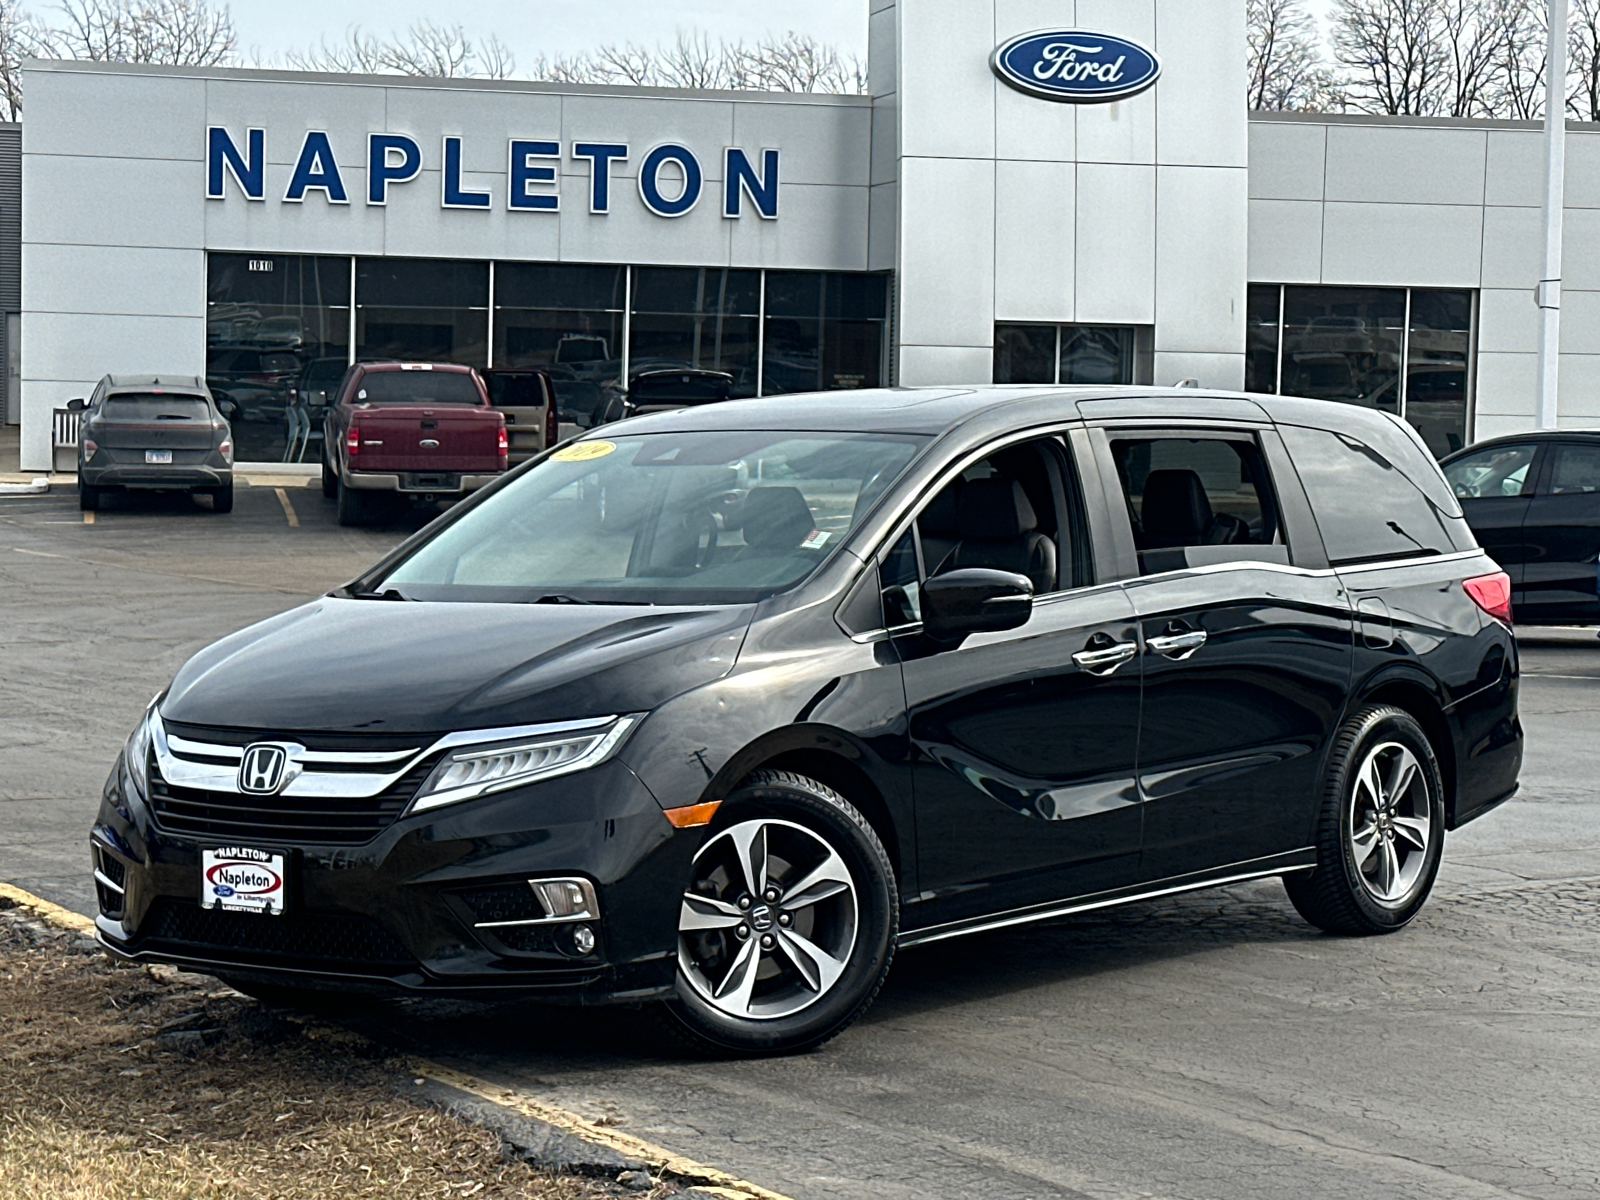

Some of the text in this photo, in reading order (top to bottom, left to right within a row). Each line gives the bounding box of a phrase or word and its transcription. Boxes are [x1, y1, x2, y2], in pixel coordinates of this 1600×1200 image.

[1033, 43, 1126, 82] Ford
[205, 125, 780, 219] NAPLETON
[250, 260, 272, 271] 1010
[218, 847, 267, 861] NAPLETON
[219, 868, 270, 888] Napleton
